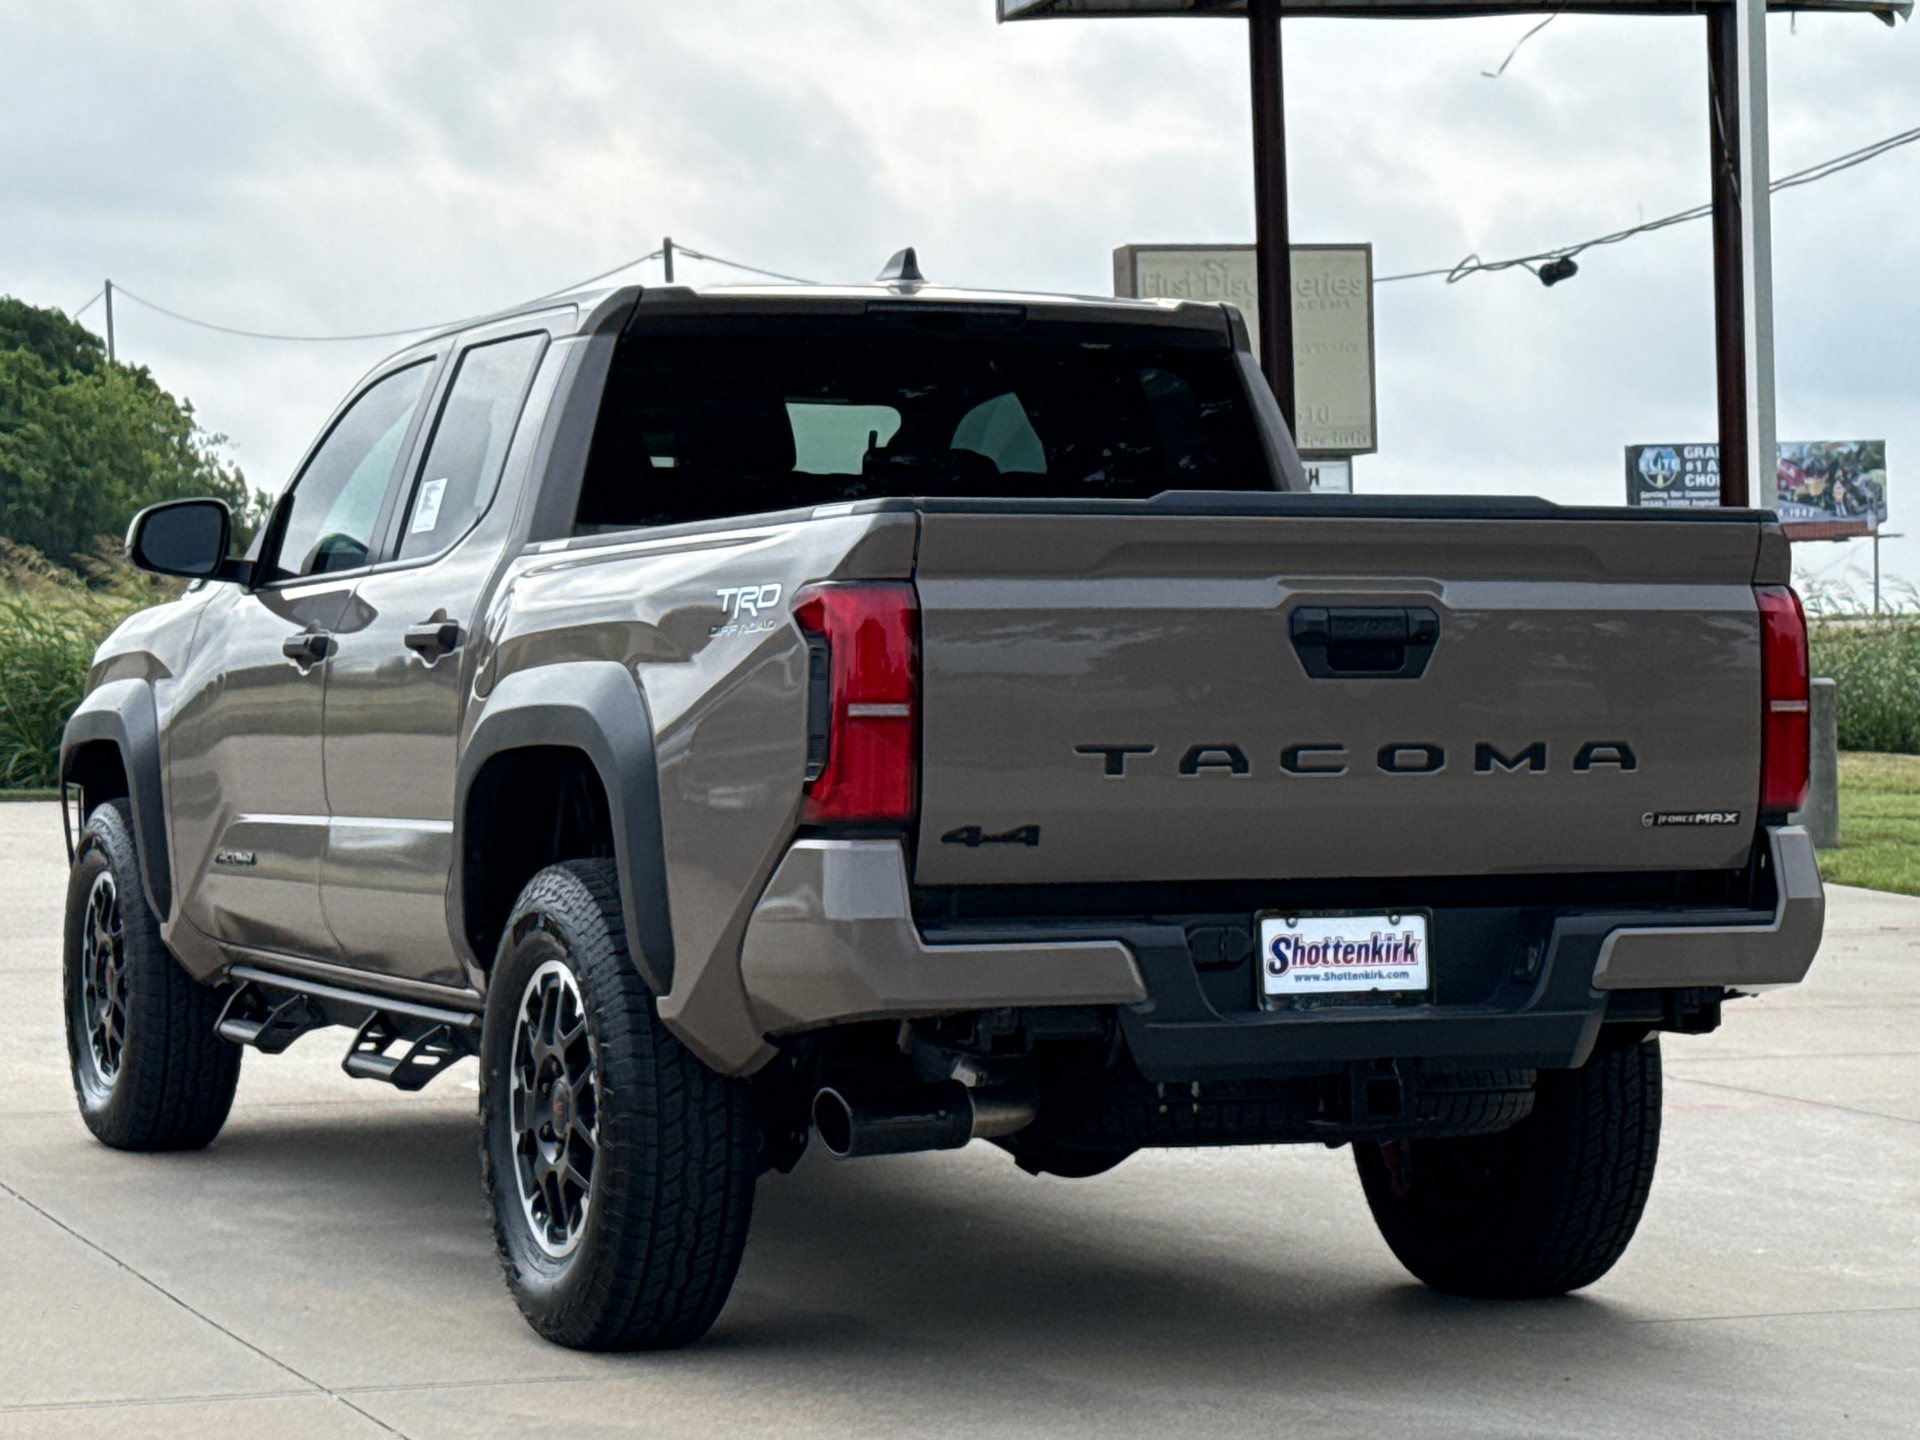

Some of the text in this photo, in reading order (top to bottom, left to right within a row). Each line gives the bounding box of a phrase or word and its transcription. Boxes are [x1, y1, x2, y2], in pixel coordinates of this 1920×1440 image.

[717, 584, 782, 619] TRD
[1073, 740, 1638, 779] TACOMA
[1266, 931, 1421, 978] Shottenkirk
[1294, 970, 1409, 983] www.Shottenkirk.com
